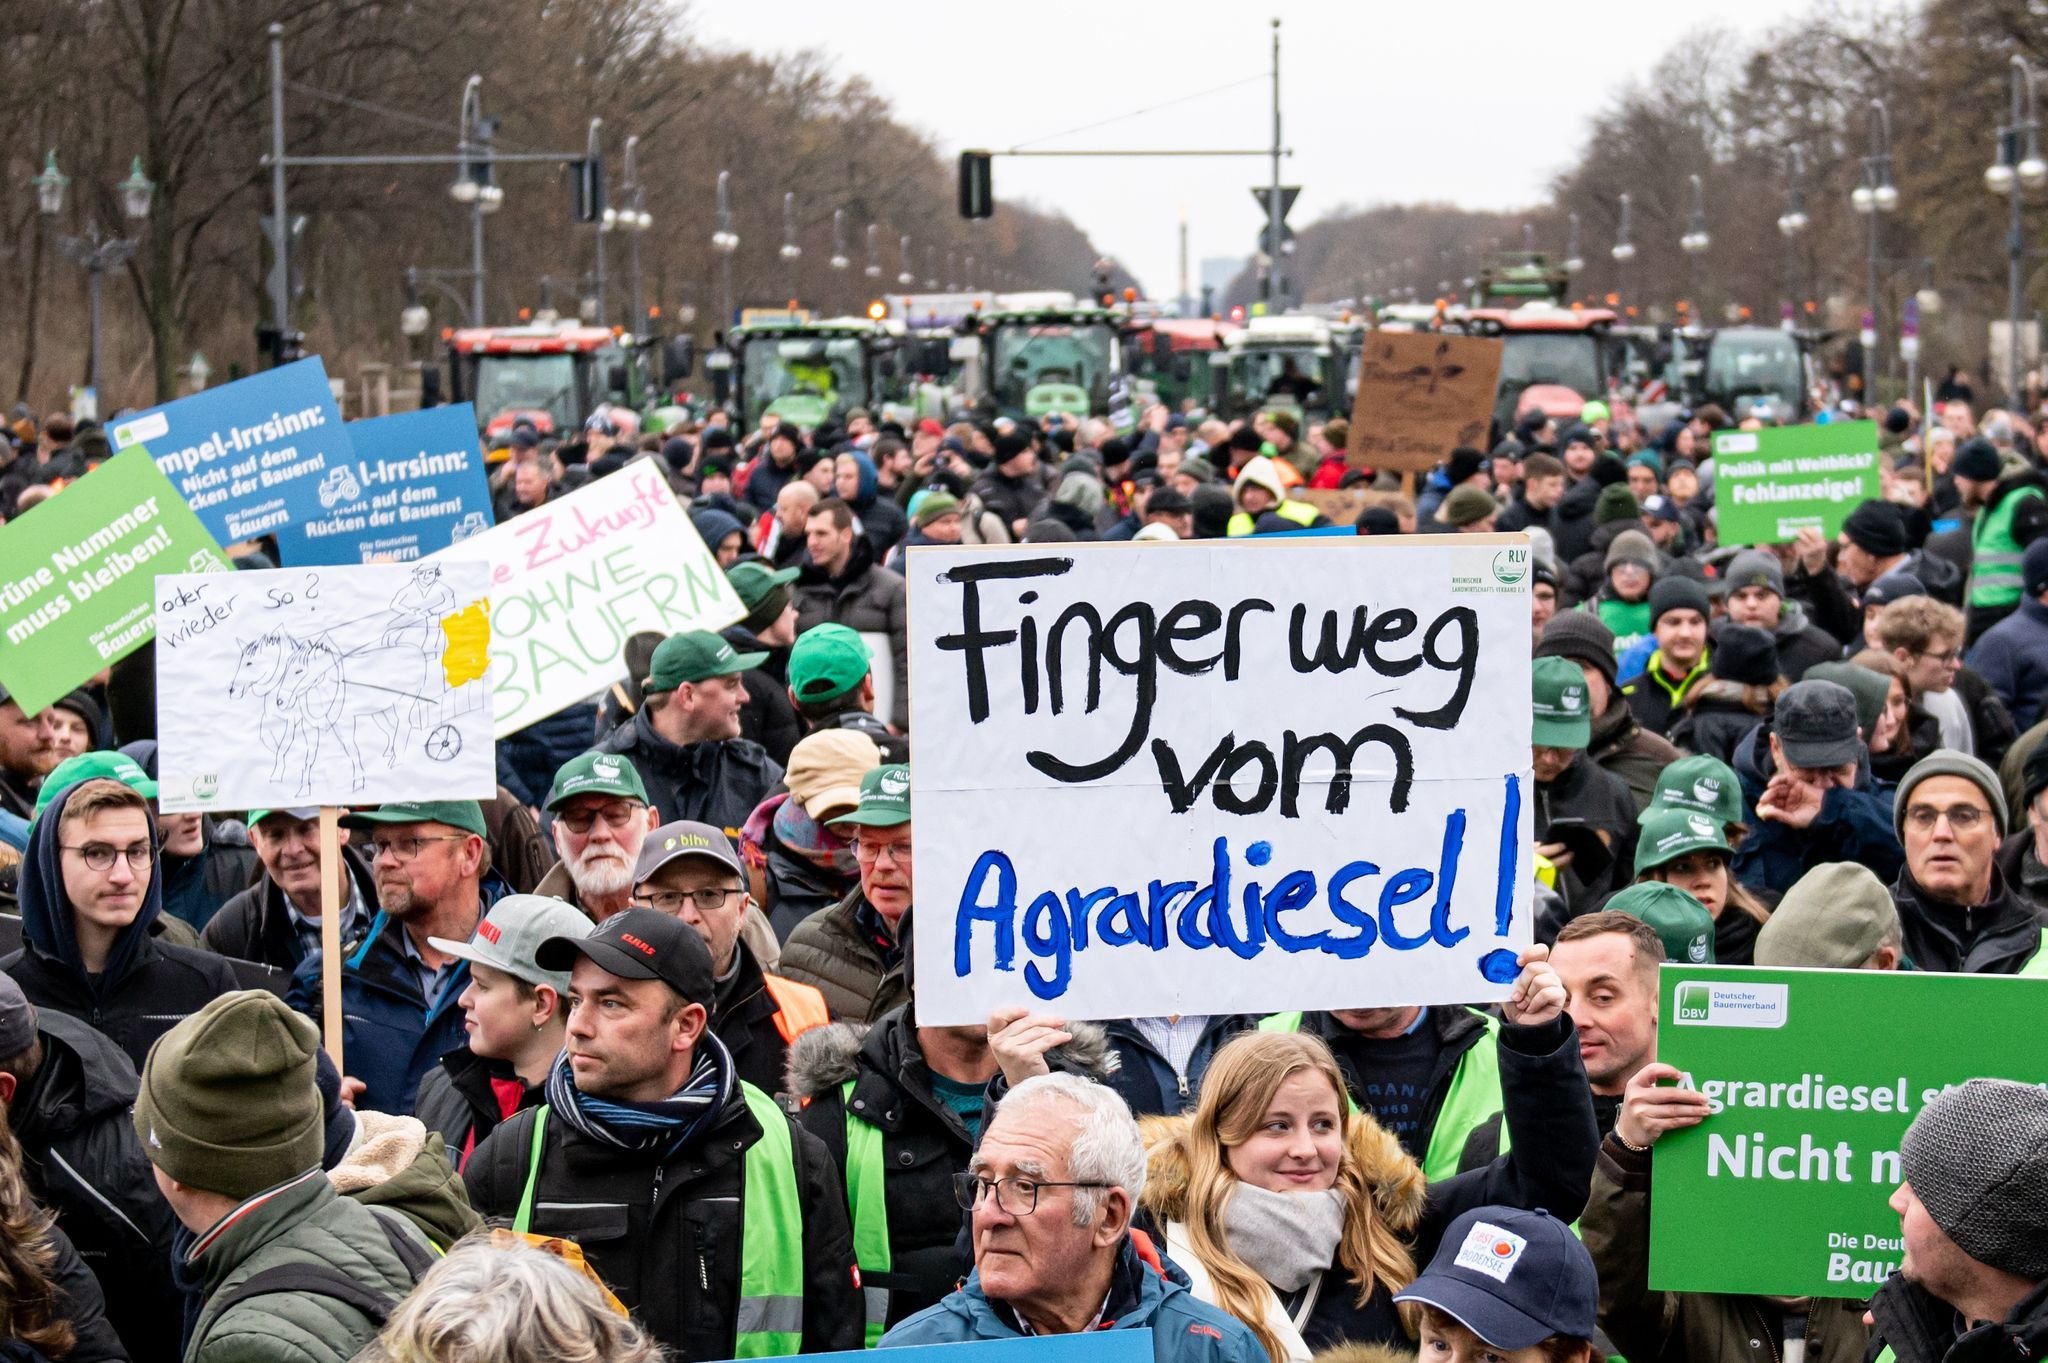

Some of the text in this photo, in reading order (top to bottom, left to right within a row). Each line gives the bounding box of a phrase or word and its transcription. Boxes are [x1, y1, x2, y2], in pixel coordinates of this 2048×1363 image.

[156, 406, 326, 475] mpel-Irrsinn:
[182, 446, 298, 494] Nicht auf dem
[188, 453, 326, 511] cken der Bauern!
[360, 451, 469, 486] l-Irrsinn:
[1719, 453, 1874, 478] Politik mit Weitblick?
[372, 489, 398, 509] auf
[401, 486, 437, 504] dem
[1732, 476, 1863, 505] Fehlanzeige!
[229, 509, 290, 540] Bauern
[305, 497, 463, 539] Rücken der Bauern!
[514, 473, 670, 571] Zukunft
[0, 496, 160, 613] rüne Nummer
[1508, 549, 1527, 563] RLV
[6, 525, 173, 645] muss bleiben!
[162, 583, 209, 612] oder
[490, 544, 646, 639] OHNE
[96, 613, 157, 660] Bauern
[162, 594, 239, 649] wieder
[491, 552, 722, 723] BAUERN
[935, 557, 1480, 783] Finger weg
[204, 774, 218, 784] RLV
[602, 756, 620, 767] RLV
[1151, 722, 1414, 819] vom
[1704, 777, 1720, 789] RLV
[680, 833, 710, 847] blhv
[954, 772, 1522, 1001] Agrardiesel!
[1681, 1001, 1777, 1019] DBV Bauernverband
[1714, 992, 1756, 1000] Deutscher
[1707, 1132, 1853, 1183] Nicht
[1828, 1232, 1905, 1251] Die Deut
[1826, 1253, 1893, 1284] Bau
